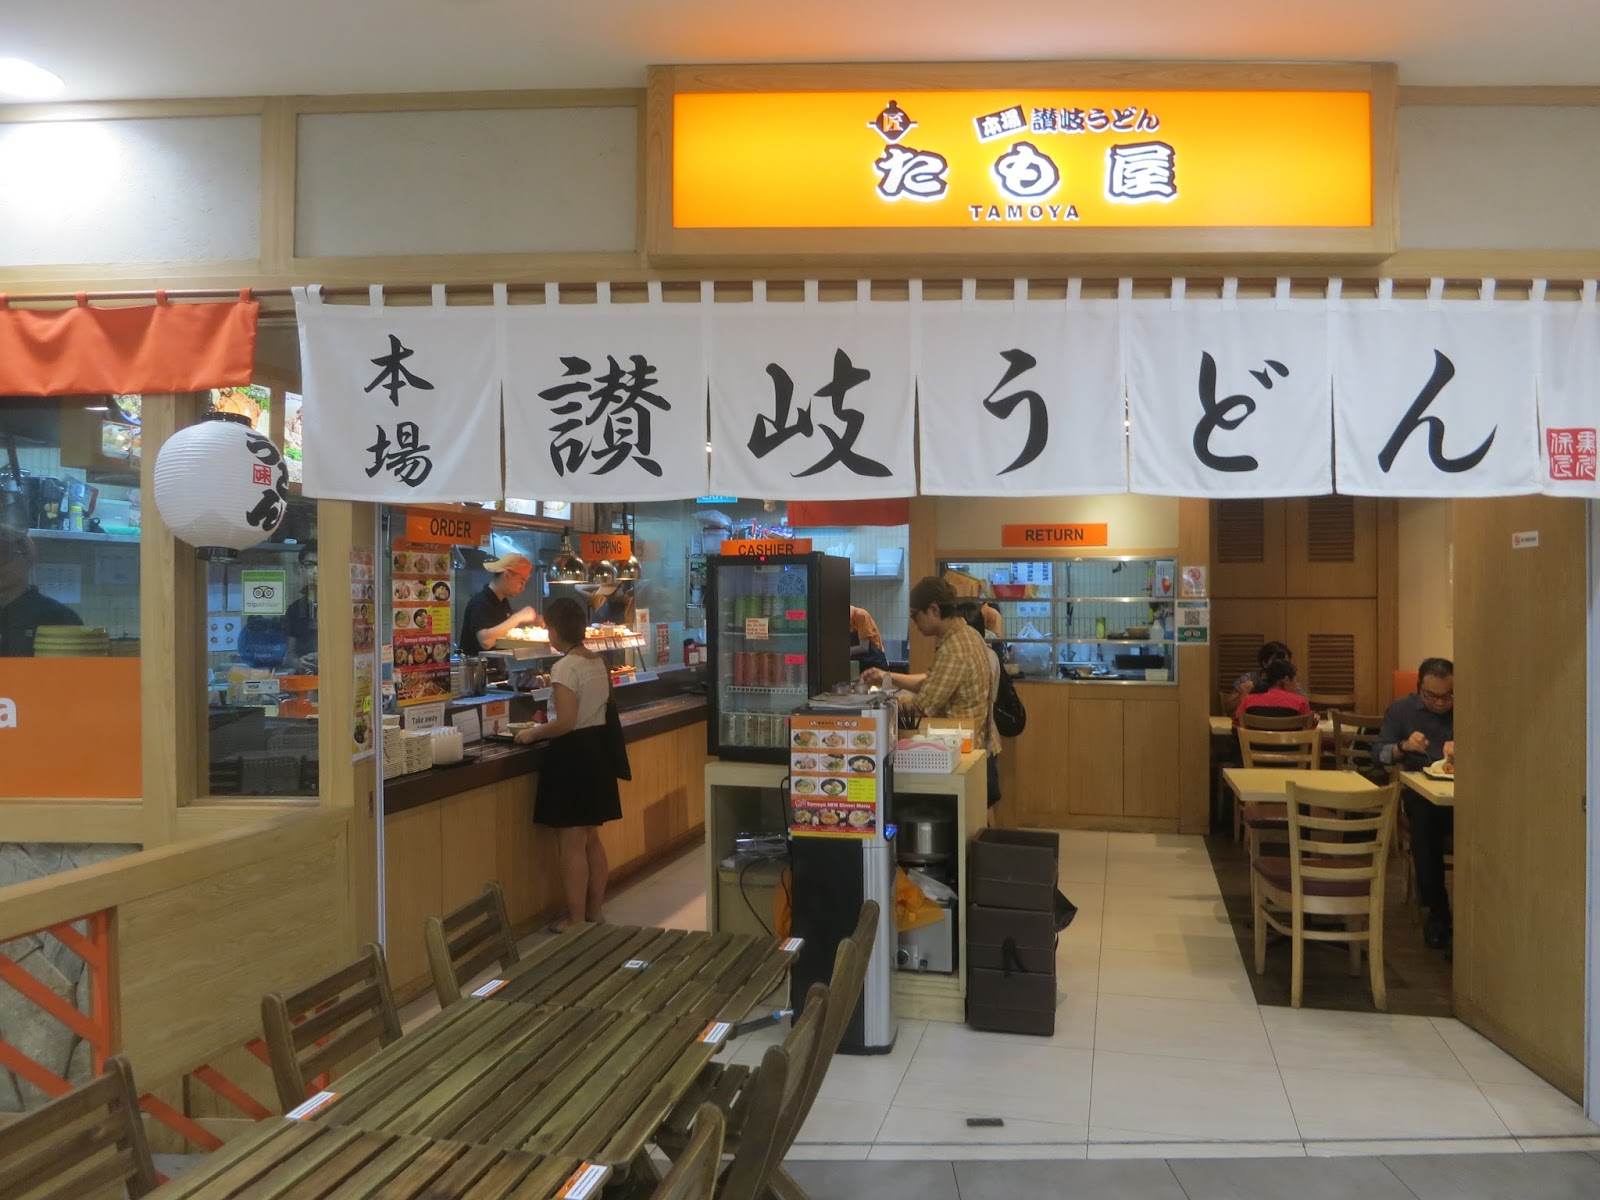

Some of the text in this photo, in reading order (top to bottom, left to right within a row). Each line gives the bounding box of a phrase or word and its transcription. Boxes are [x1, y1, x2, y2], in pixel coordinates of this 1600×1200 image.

[970, 205, 1080, 221] TAMOYA
[364, 333, 435, 488] 本場
[430, 517, 472, 538] ORDER
[1025, 528, 1084, 541] RETURN
[591, 540, 622, 555] TOPPING
[738, 543, 794, 556] CASHIER
[412, 716, 423, 725] Take
